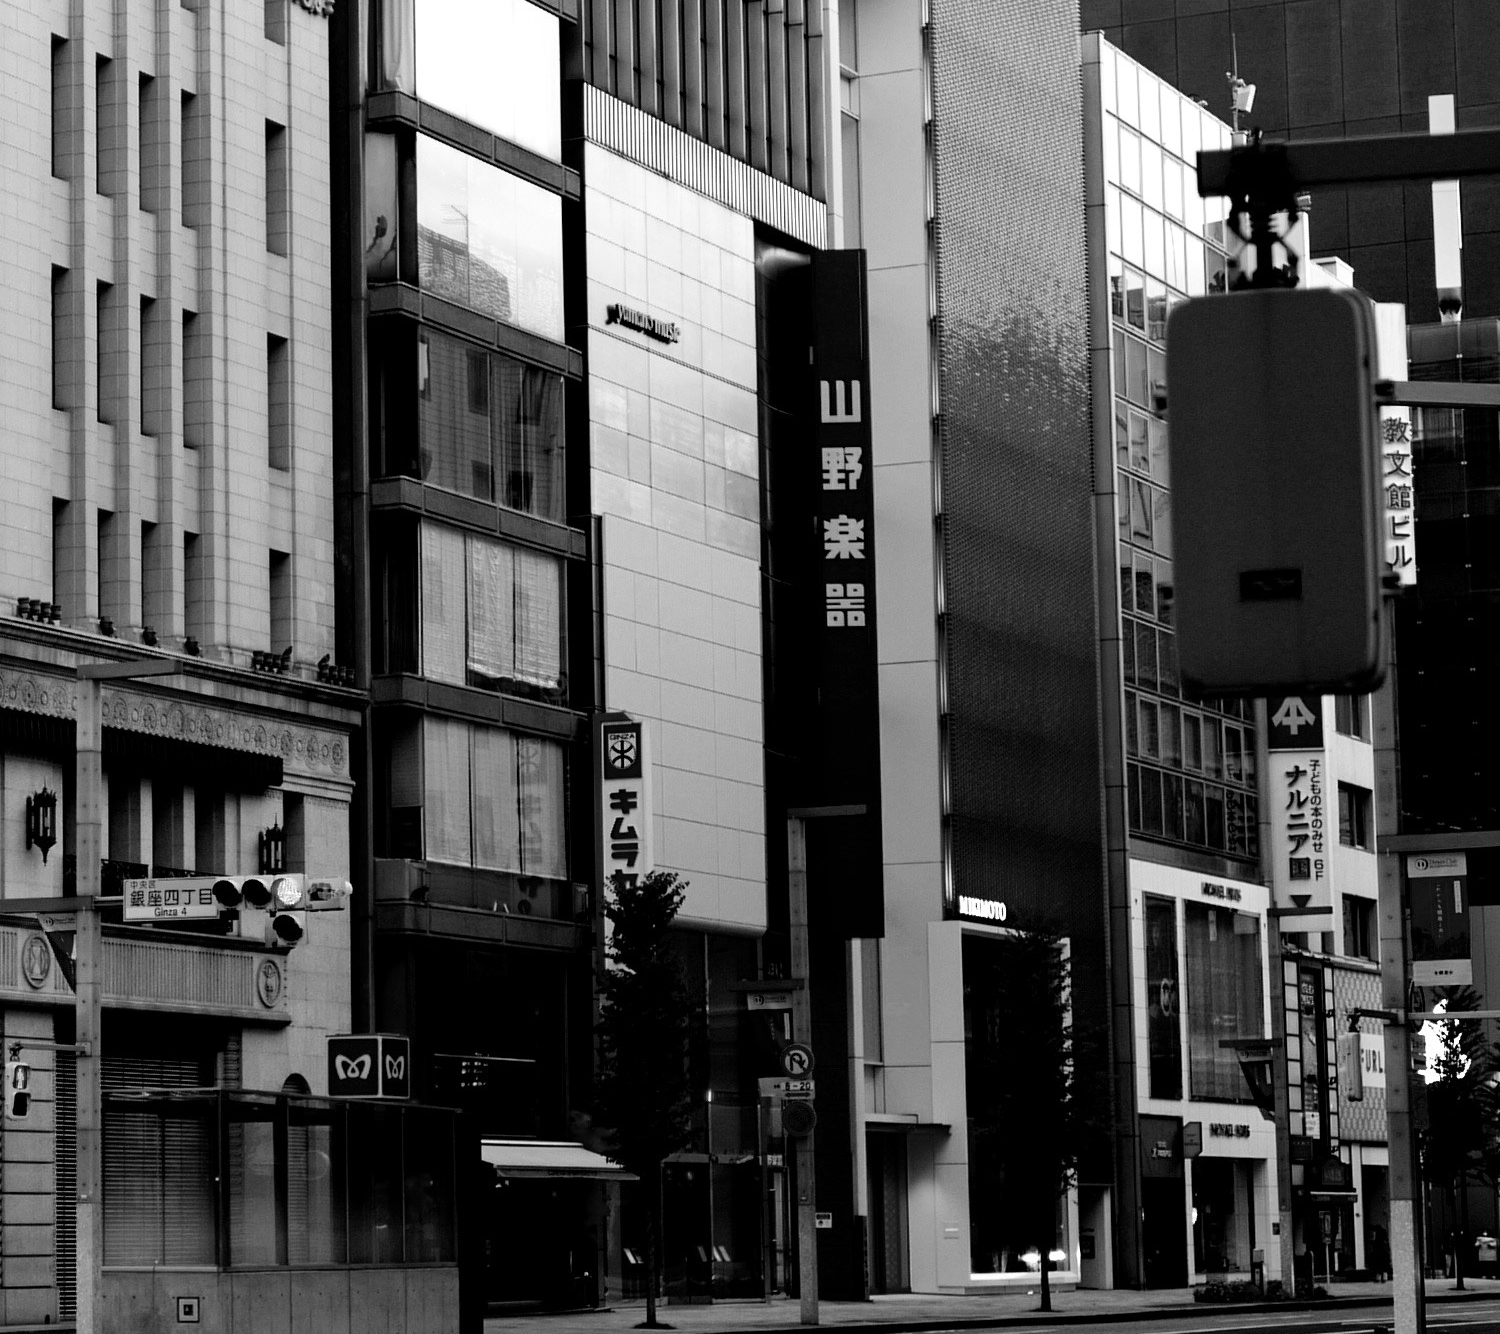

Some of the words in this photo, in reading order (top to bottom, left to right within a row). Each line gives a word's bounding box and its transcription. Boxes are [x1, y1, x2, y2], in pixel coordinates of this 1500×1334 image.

[820, 379, 866, 627] 山野楽器
[1383, 417, 1413, 567] 教文館ビル
[1285, 766, 1310, 881] ナルニア国
[1314, 860, 1324, 882] 6F
[130, 880, 156, 889] 中央区
[130, 889, 213, 907] 銀座四丁目
[154, 907, 177, 917] Ginza
[181, 908, 187, 916] 4
